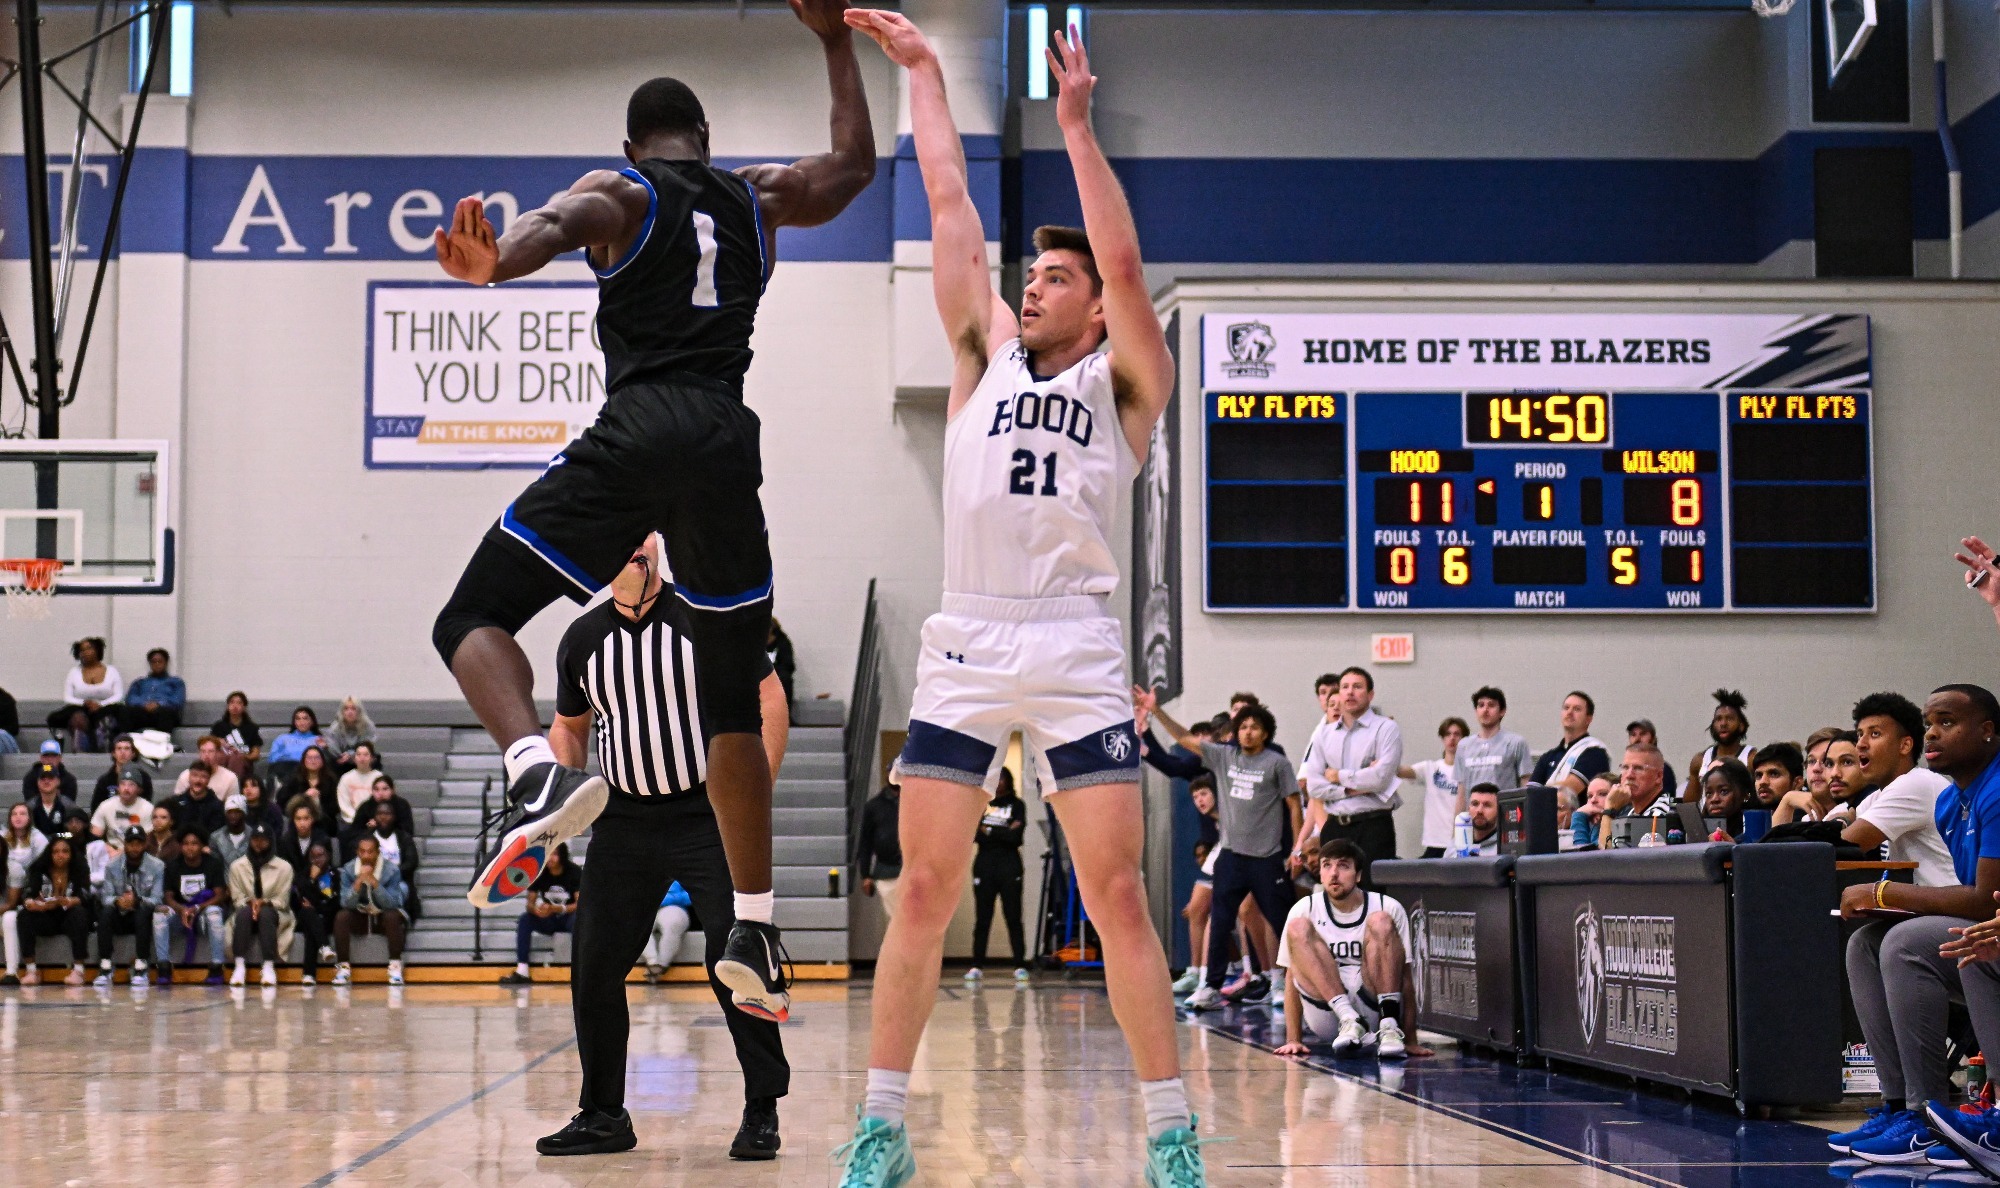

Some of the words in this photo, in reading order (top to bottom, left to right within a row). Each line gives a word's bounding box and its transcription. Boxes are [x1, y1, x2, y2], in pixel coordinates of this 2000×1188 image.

[212, 164, 569, 254] Aren
[692, 209, 718, 307] 1
[384, 311, 501, 351] THINK
[519, 311, 602, 351] BEF
[1303, 339, 1407, 363] HOME
[1417, 339, 1459, 363] OF
[1468, 339, 1541, 363] THE
[1550, 339, 1711, 363] BLAZERS
[415, 362, 499, 402] YOU
[519, 362, 607, 402] DRIN
[988, 391, 1093, 447] HOOD
[1217, 395, 1255, 418] PLY
[1264, 395, 1290, 418] FL
[1294, 395, 1335, 418] PTS
[1490, 395, 1605, 442] 14:50
[1740, 395, 1777, 418] PLY
[1786, 395, 1811, 418] FL
[1817, 395, 1856, 418] PTS
[375, 419, 419, 434] STAY
[425, 426, 447, 439] IN
[450, 426, 489, 439] THE
[495, 426, 558, 439] KNOW
[1010, 448, 1058, 496] 21
[1390, 450, 1440, 473] HOOD
[1514, 462, 1566, 479] PERIOD
[1622, 450, 1696, 473] WILSON
[1410, 482, 1453, 523] 11
[1540, 486, 1552, 519] 1
[1671, 479, 1701, 526] 8
[1374, 530, 1420, 545] FOULS
[1493, 530, 1547, 545] PLAYER
[1550, 530, 1586, 545] FOUL
[1605, 530, 1644, 545] T.O.L.
[1660, 530, 1706, 545] FOULS
[1390, 547, 1415, 584] 0
[1443, 547, 1469, 585] 6
[1611, 547, 1636, 585] 5
[1690, 550, 1701, 582] 1
[1374, 591, 1408, 606] WON
[1514, 591, 1566, 606] MATCH
[1666, 591, 1701, 606] WON
[1380, 637, 1408, 658] EXIT
[1605, 983, 1679, 1056] BLAZERS
